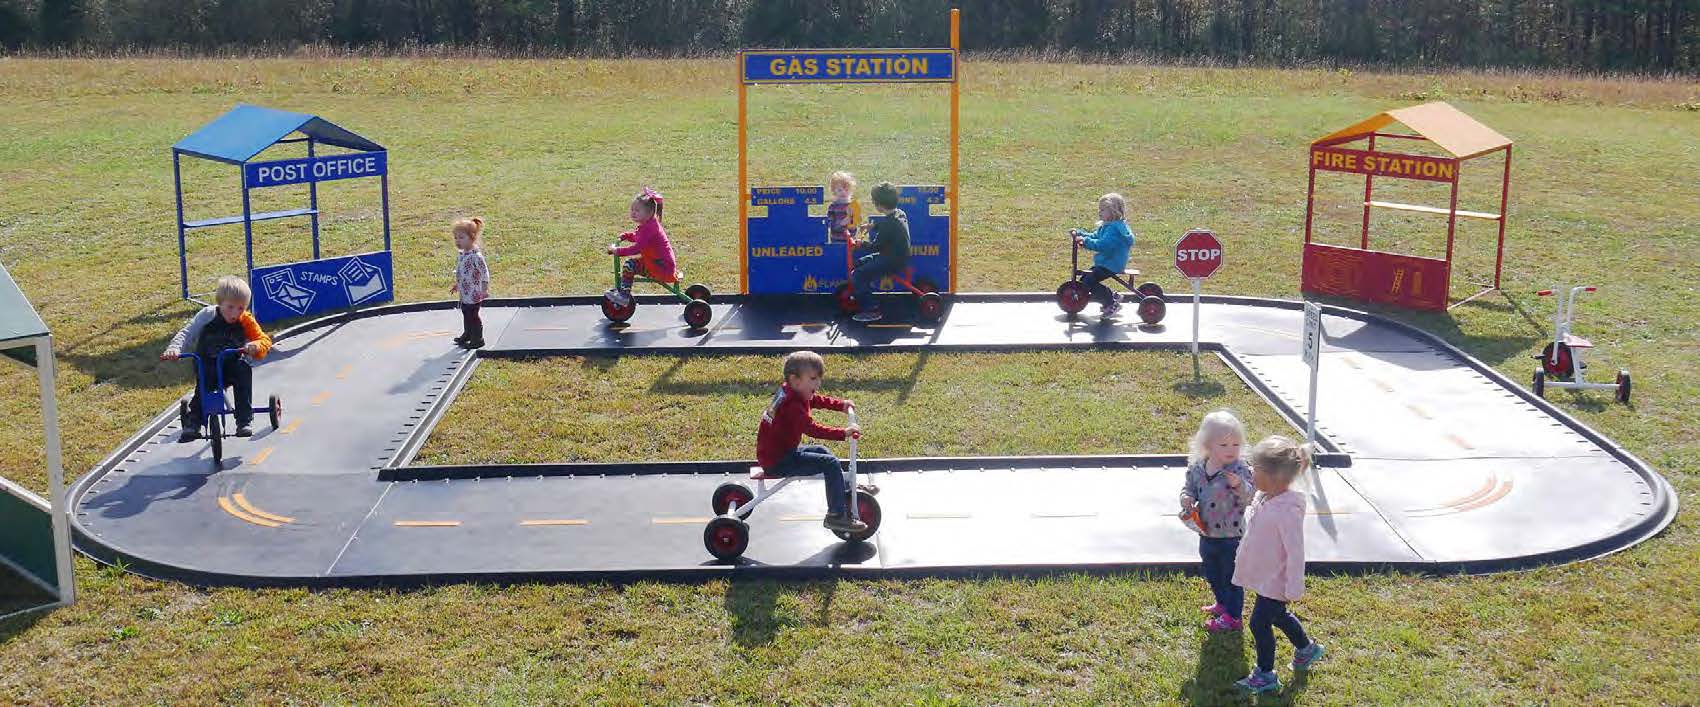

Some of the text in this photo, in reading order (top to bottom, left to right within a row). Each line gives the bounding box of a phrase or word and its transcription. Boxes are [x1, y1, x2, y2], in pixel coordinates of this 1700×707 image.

[770, 58, 928, 75] GAS STATION
[259, 157, 376, 183] POST OFFICE
[1313, 151, 1455, 178] FIRE STATION
[752, 246, 823, 257] UNLEADED
[1177, 249, 1221, 261] STOP
[300, 271, 338, 286] STAMPS
